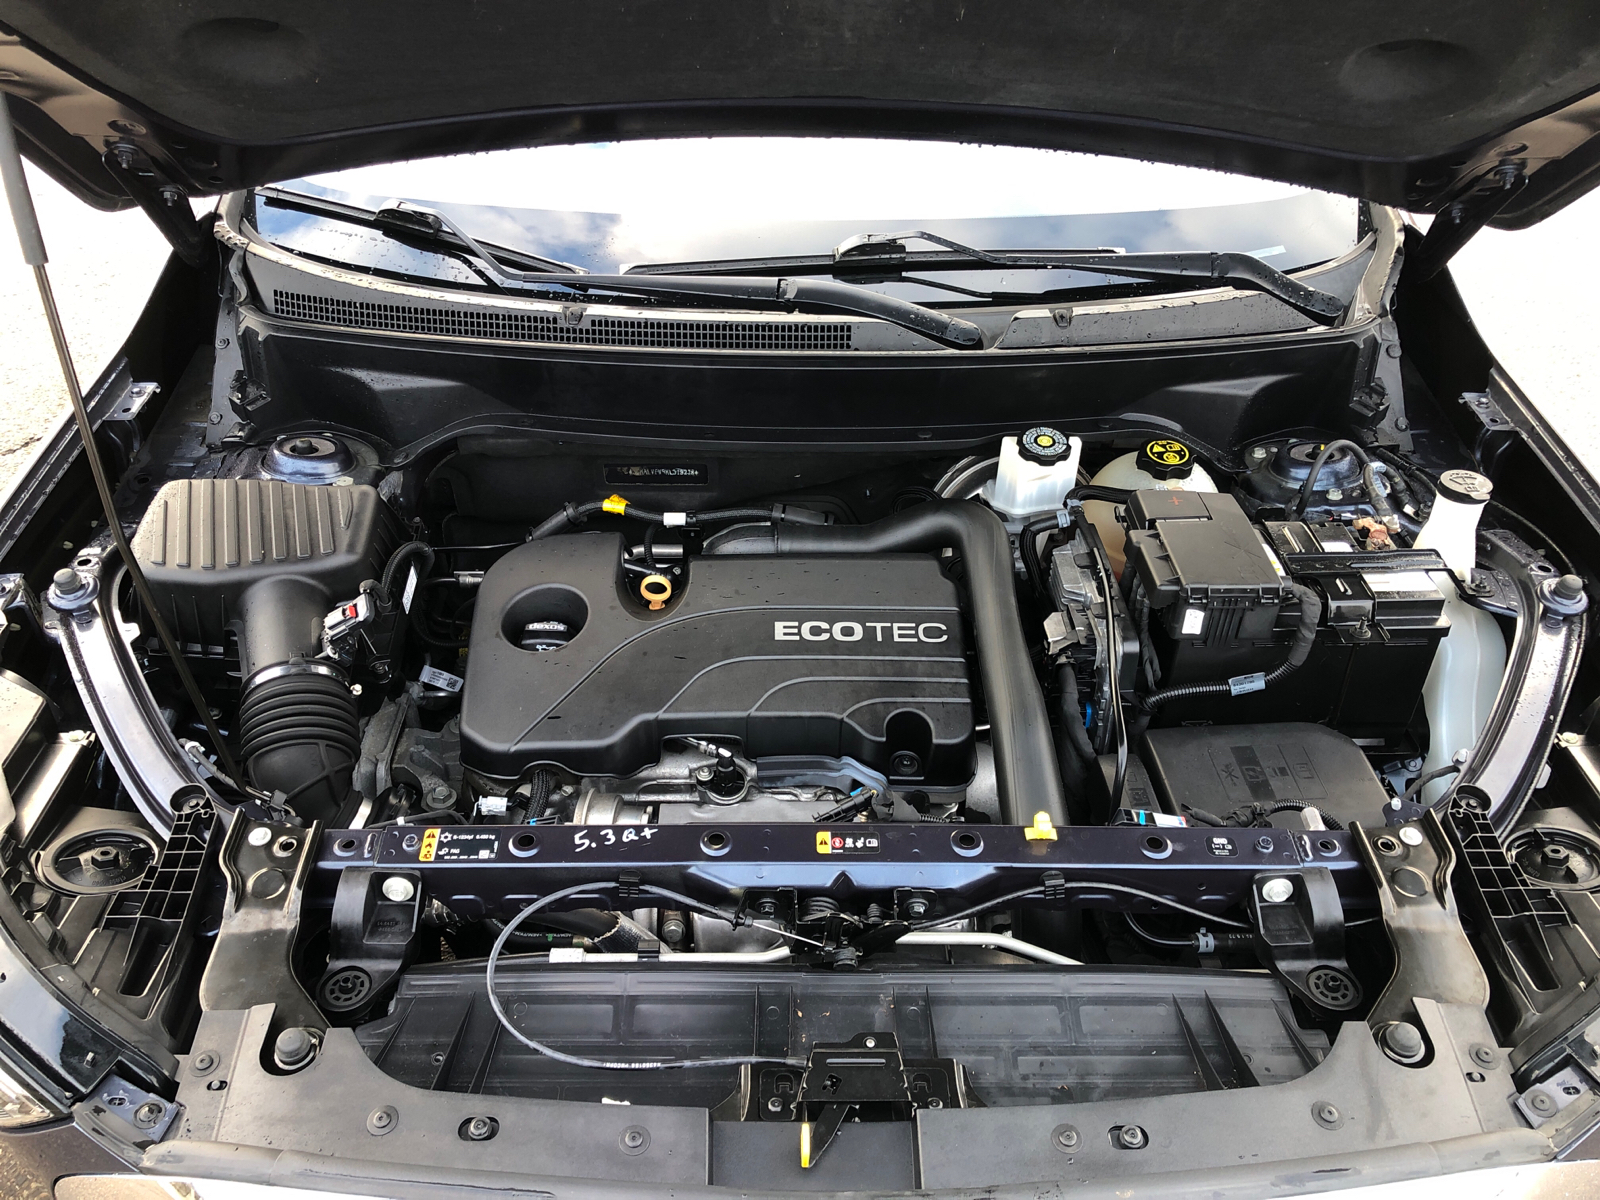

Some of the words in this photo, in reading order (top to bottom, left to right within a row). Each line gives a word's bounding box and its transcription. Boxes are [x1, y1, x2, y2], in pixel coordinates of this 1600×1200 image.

[528, 622, 564, 631] dexos
[774, 621, 948, 643] ECOTEC
[574, 828, 616, 852] 5.3
